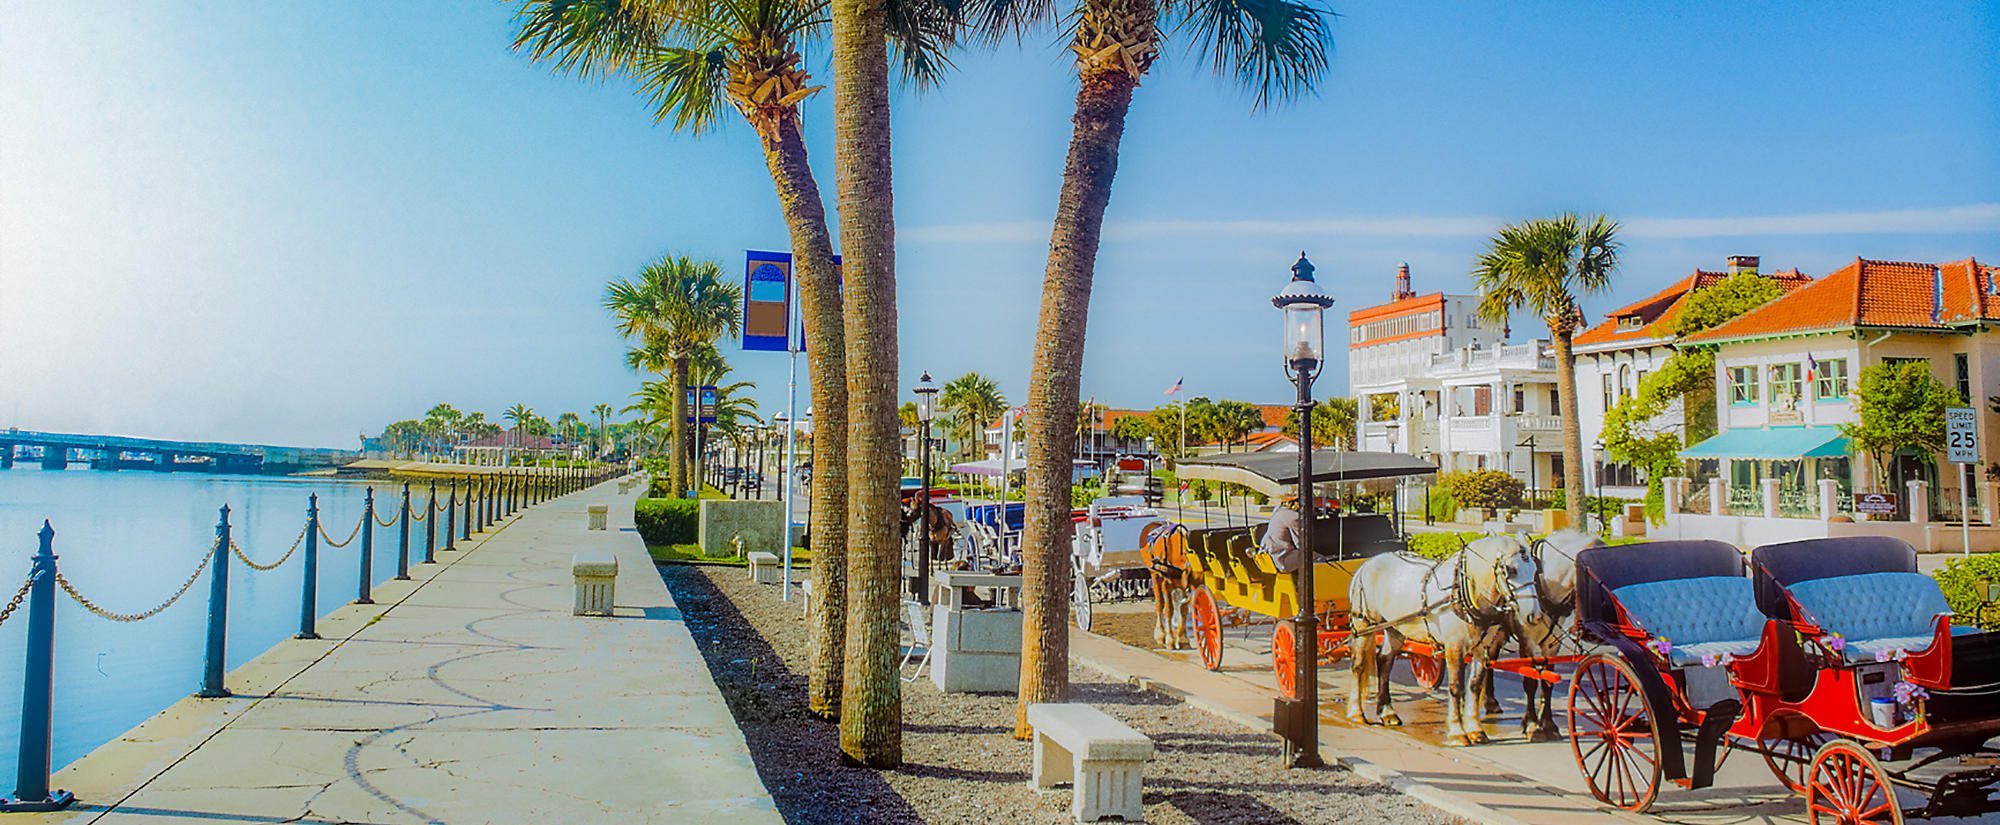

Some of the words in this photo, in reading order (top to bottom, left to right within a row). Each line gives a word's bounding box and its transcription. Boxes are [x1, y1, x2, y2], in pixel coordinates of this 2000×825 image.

[1949, 412, 1974, 421] SPEED
[1951, 422, 1972, 430] LIMIT
[1950, 431, 1975, 448] 25
